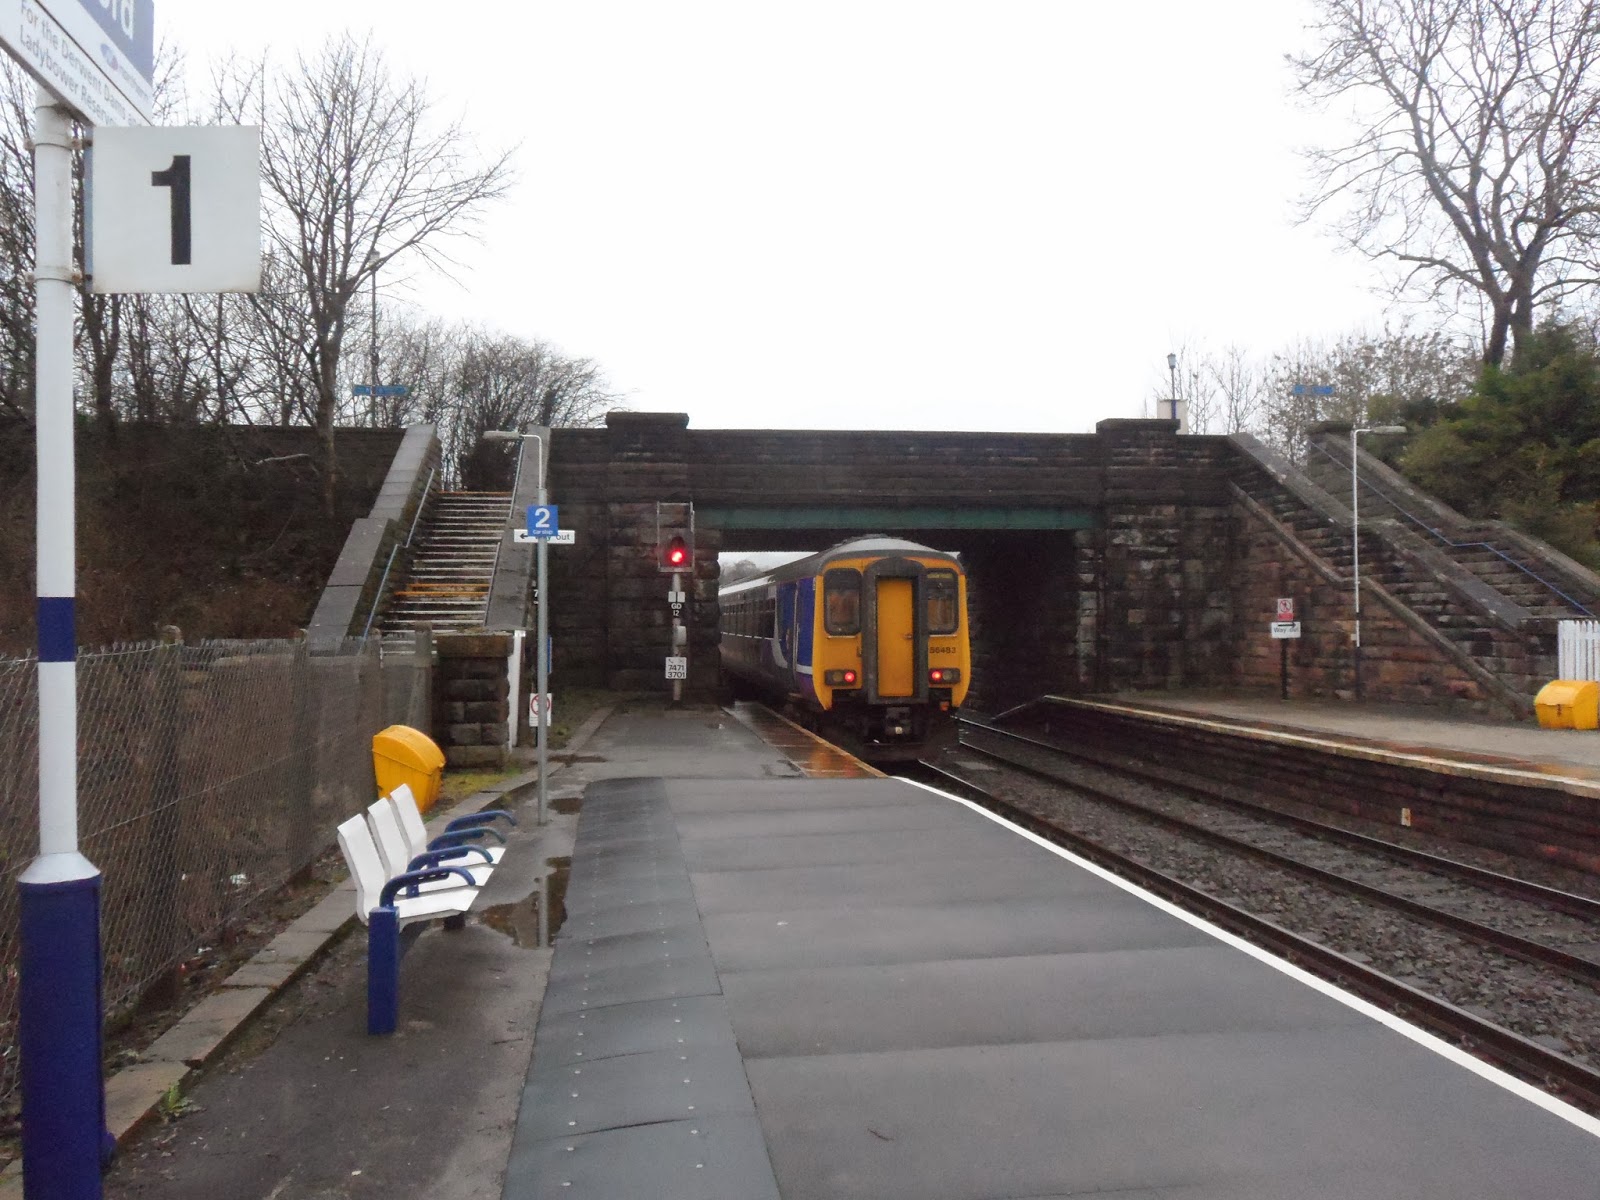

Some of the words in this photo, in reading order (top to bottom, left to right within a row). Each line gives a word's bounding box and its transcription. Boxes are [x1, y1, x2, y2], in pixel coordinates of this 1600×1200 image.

[20, 24, 79, 95] Ladybower
[21, 0, 39, 29] For
[42, 20, 58, 50] the
[62, 39, 102, 95] Derwent
[151, 154, 192, 265] 1
[534, 507, 550, 528] 2
[555, 533, 571, 541] out
[671, 602, 682, 610] GD
